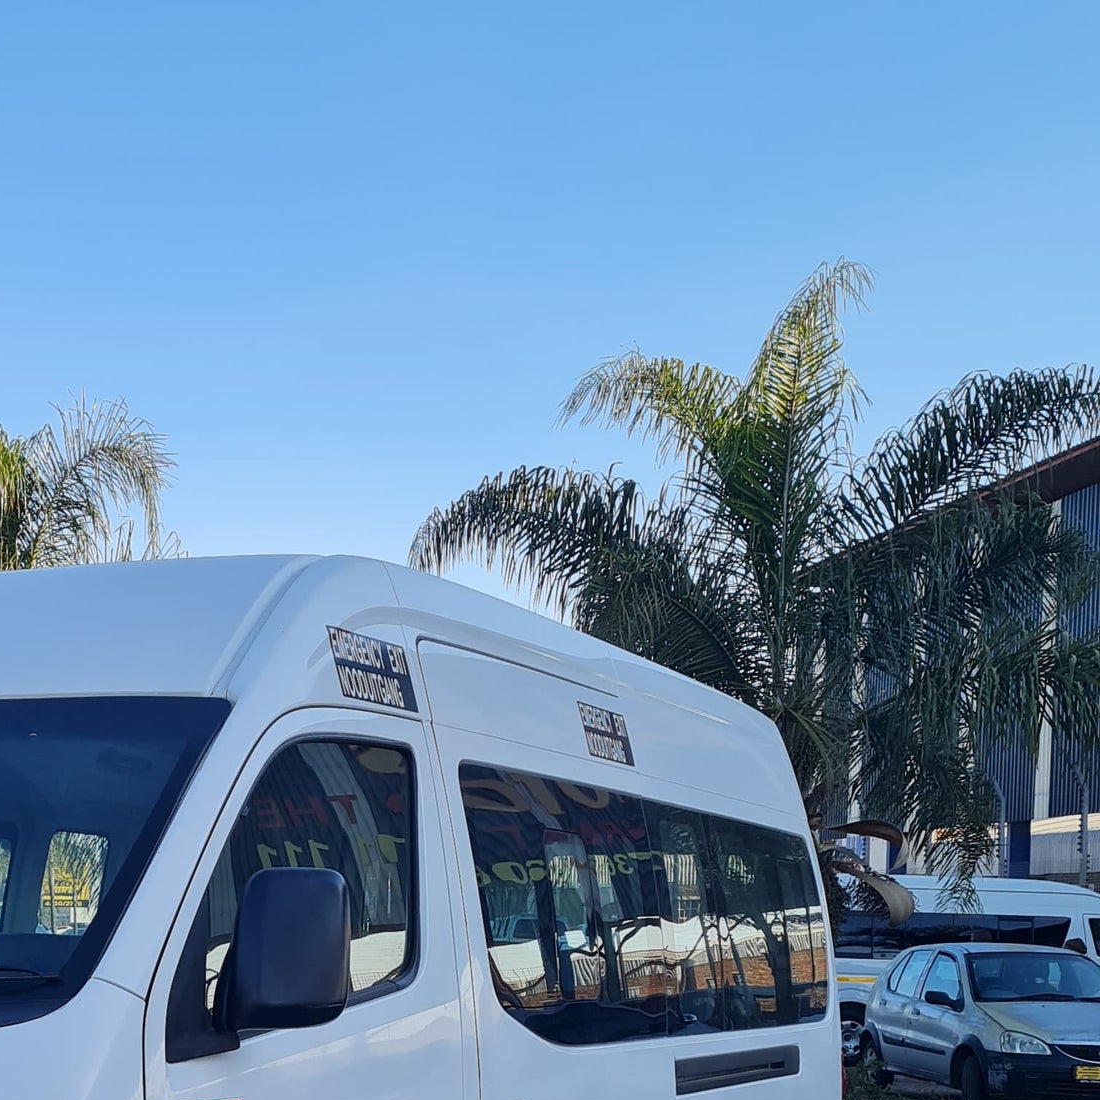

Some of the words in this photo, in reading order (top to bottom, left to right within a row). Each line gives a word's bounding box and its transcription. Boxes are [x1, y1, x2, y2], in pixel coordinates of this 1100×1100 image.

[328, 627, 385, 670] EMERGENCY
[386, 644, 407, 676] EXIT
[337, 664, 405, 708] NOODUITGANG
